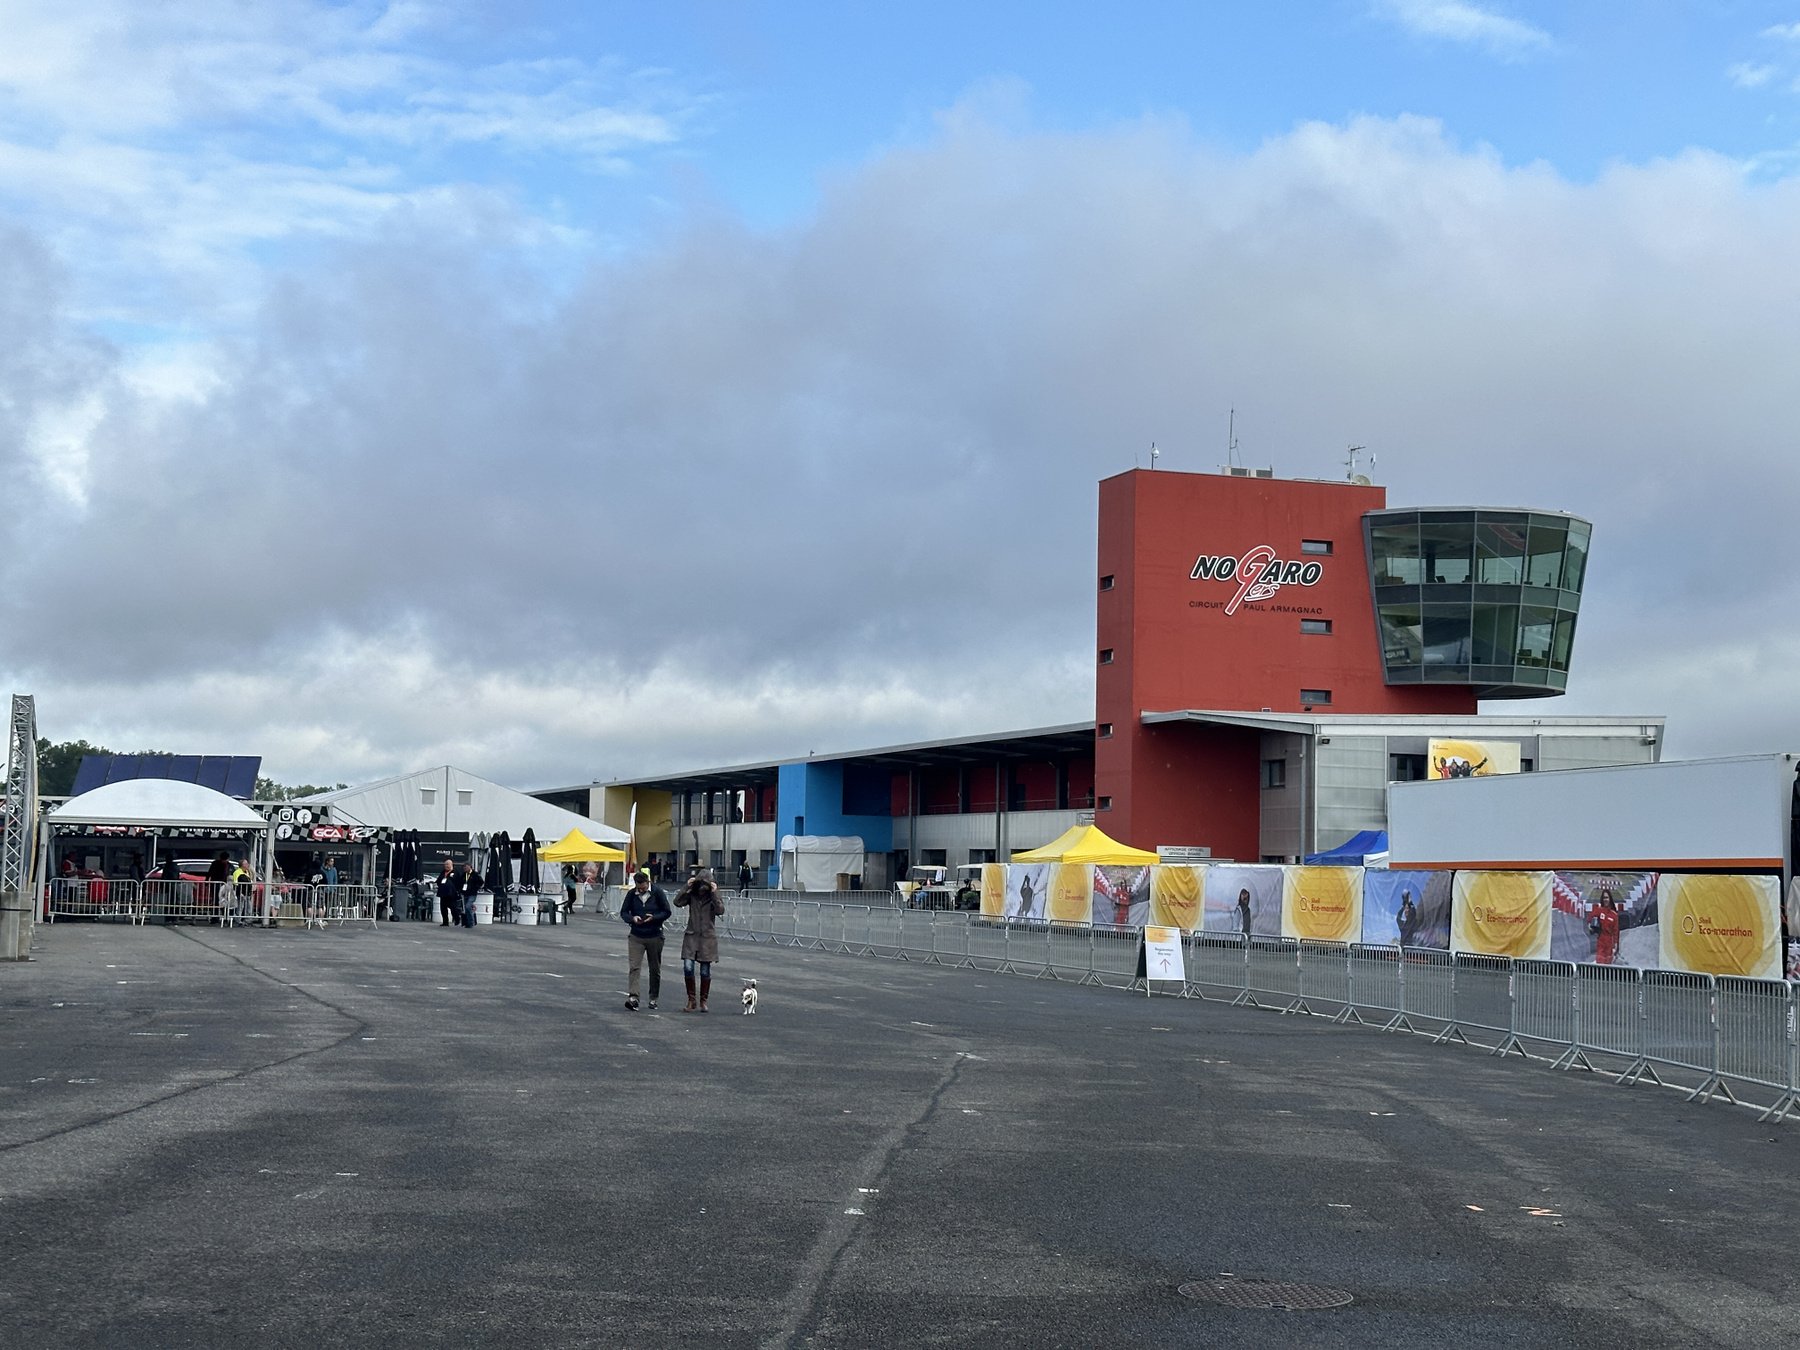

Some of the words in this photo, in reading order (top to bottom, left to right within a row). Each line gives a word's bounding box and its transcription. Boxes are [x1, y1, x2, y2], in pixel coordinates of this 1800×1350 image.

[1190, 545, 1323, 615] NOGARO
[1189, 601, 1225, 609] CIRCUIT
[1243, 603, 1265, 612] PAUL
[1270, 605, 1323, 615] ARMAGNAC
[313, 828, 342, 838] GCA
[1699, 925, 1753, 937] Eco-marathon
